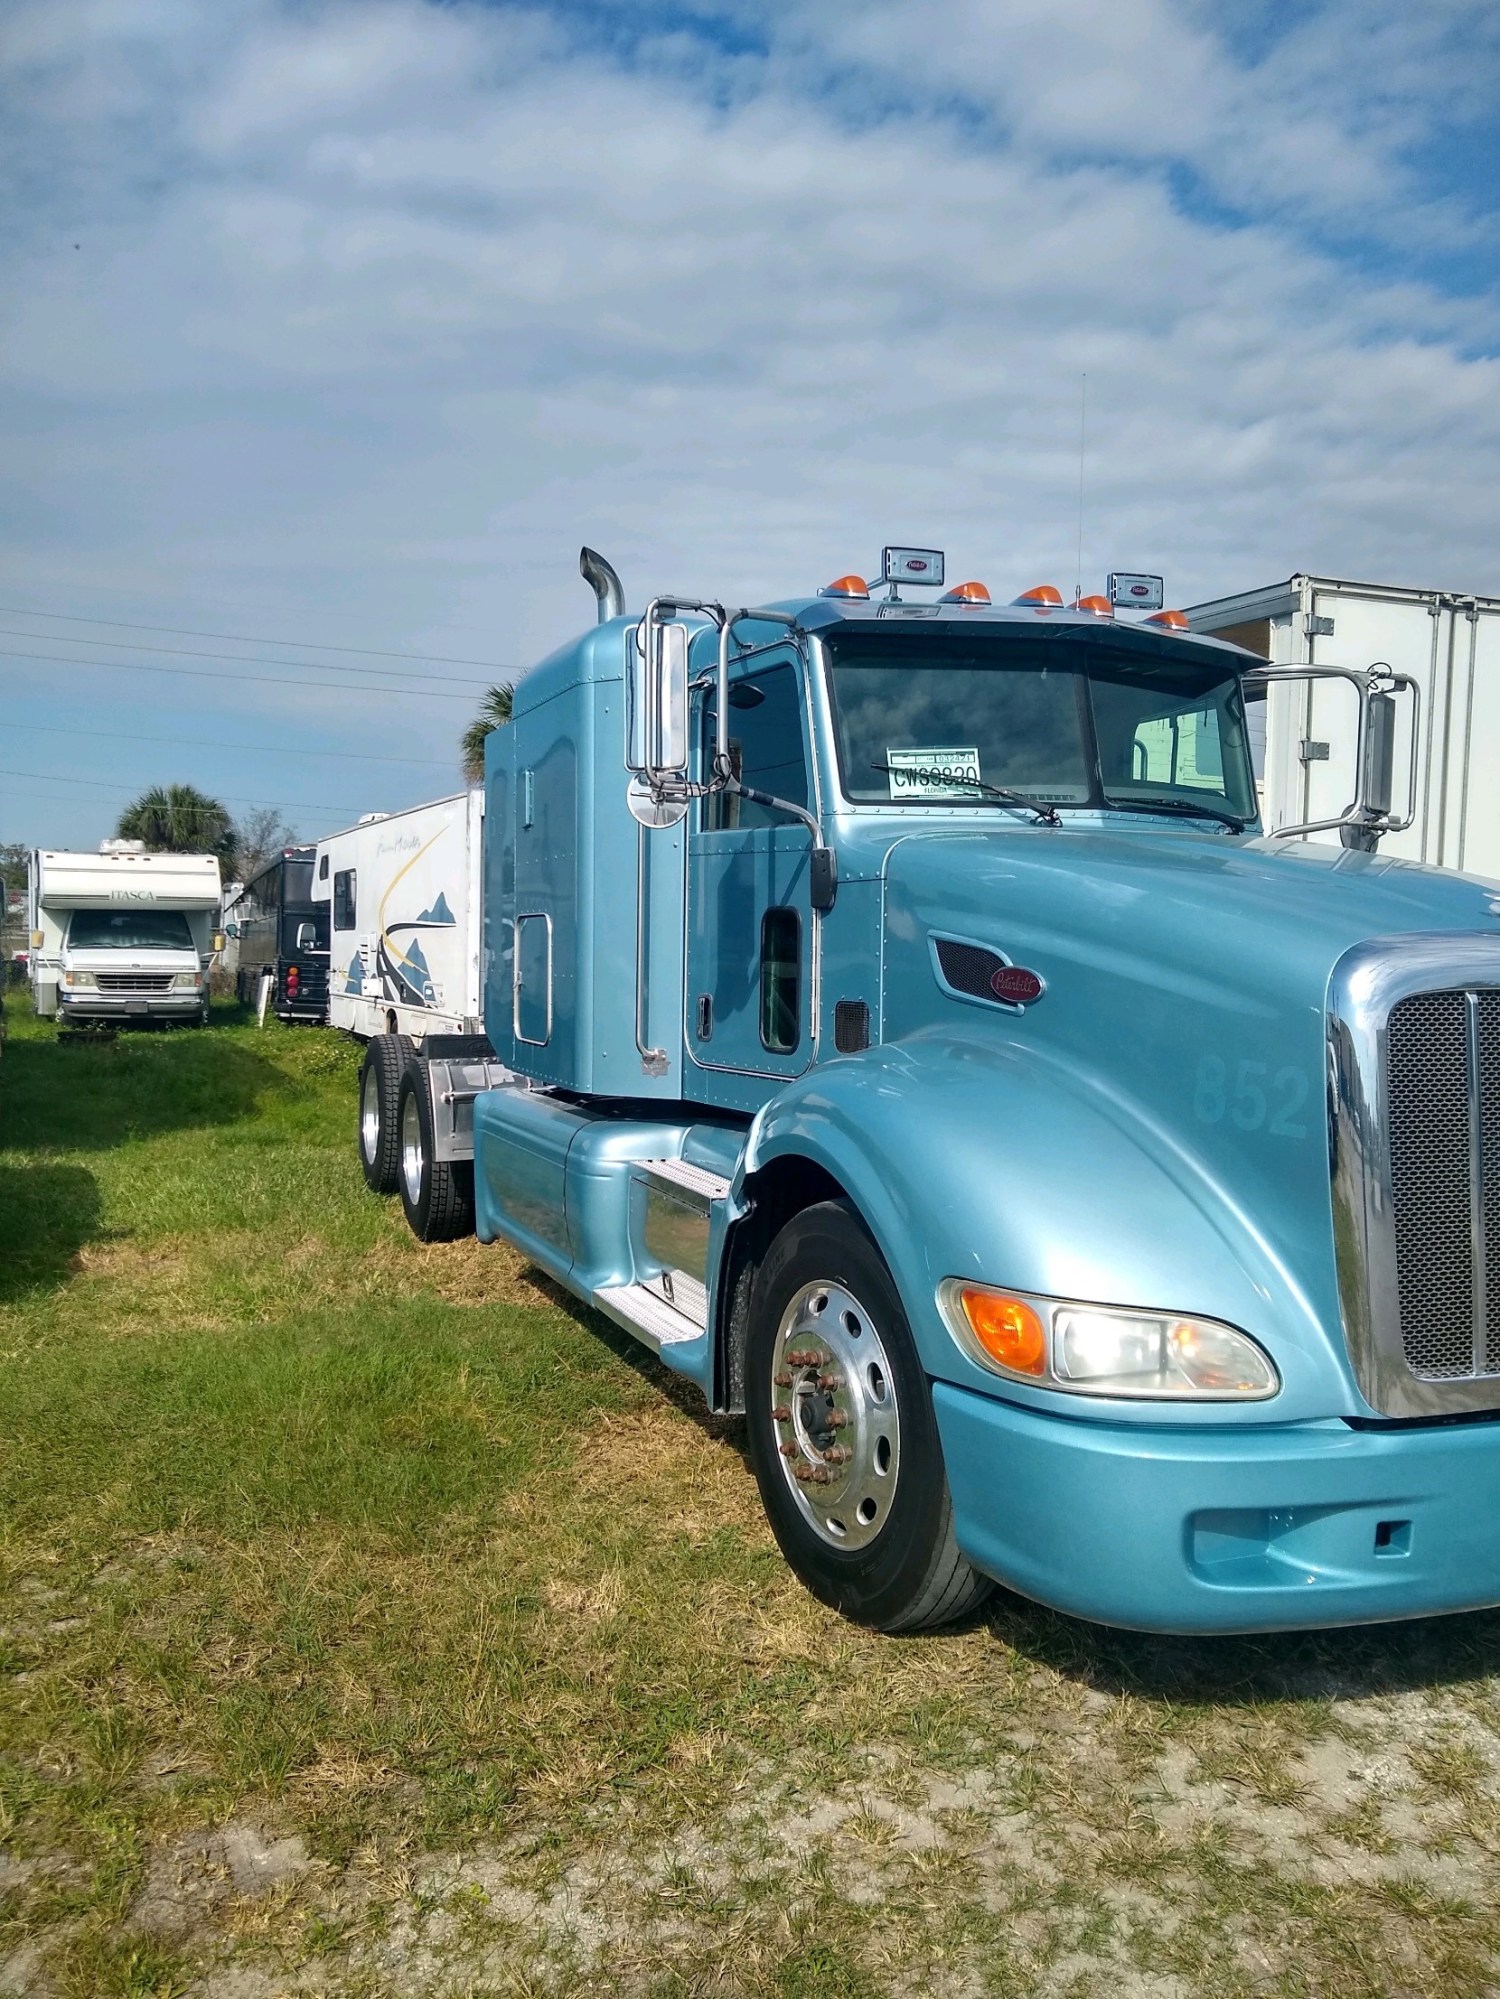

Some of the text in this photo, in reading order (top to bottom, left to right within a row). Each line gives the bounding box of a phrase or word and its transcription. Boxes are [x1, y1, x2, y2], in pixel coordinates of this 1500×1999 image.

[111, 890, 154, 901] ITASCA
[995, 972, 1037, 993] Peterbilt
[1193, 1055, 1309, 1139] 852
